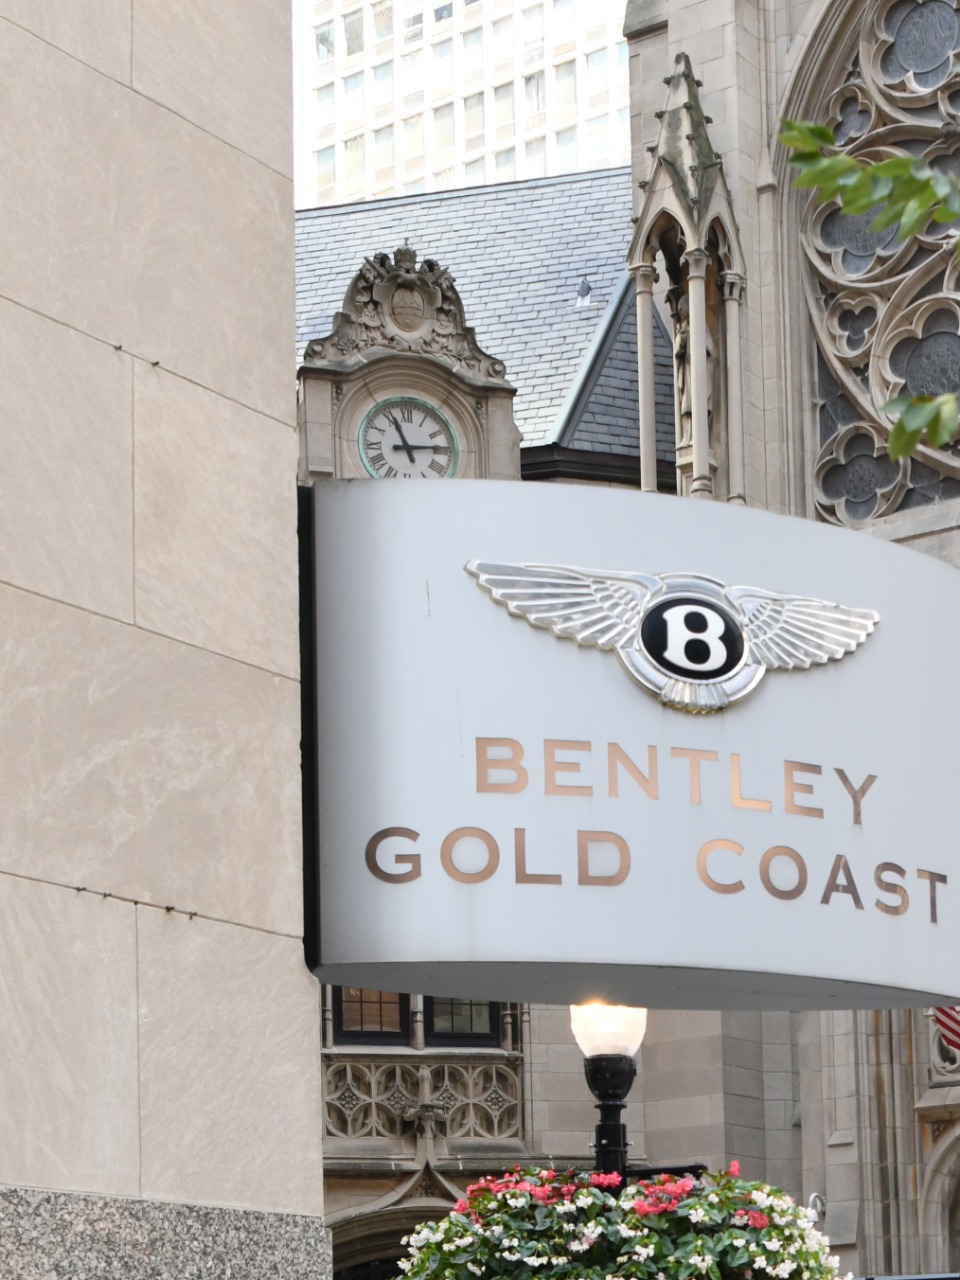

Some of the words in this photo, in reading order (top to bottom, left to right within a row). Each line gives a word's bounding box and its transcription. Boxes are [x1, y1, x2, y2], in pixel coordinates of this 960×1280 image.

[475, 736, 878, 826] BENTLEY
[364, 826, 632, 887] GOLD
[695, 838, 948, 925] COAST
